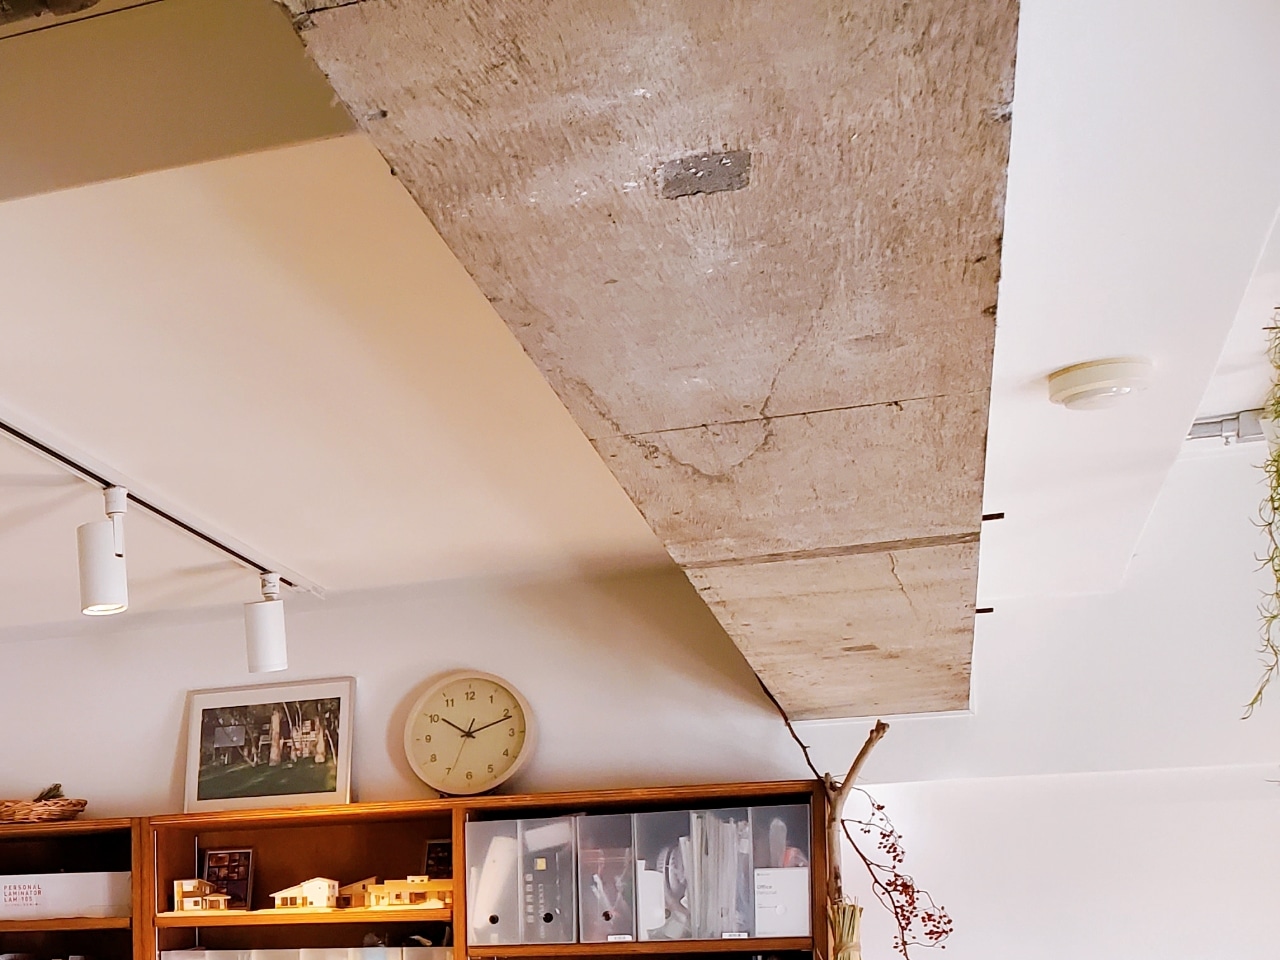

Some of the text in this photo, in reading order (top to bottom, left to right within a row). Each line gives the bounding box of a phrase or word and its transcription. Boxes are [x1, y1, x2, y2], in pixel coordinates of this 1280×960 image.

[465, 691, 476, 701] 12
[489, 695, 494, 704] 1
[445, 698, 455, 707] 11
[503, 708, 509, 718] 2
[428, 714, 439, 723] 10
[508, 728, 515, 737] 3
[425, 734, 432, 743] 9
[502, 748, 509, 757] 4
[430, 753, 437, 763] 8
[445, 767, 451, 776] 7
[487, 764, 494, 773] 5
[465, 771, 473, 780] 6
[3, 889, 42, 897] LAMINATOR
